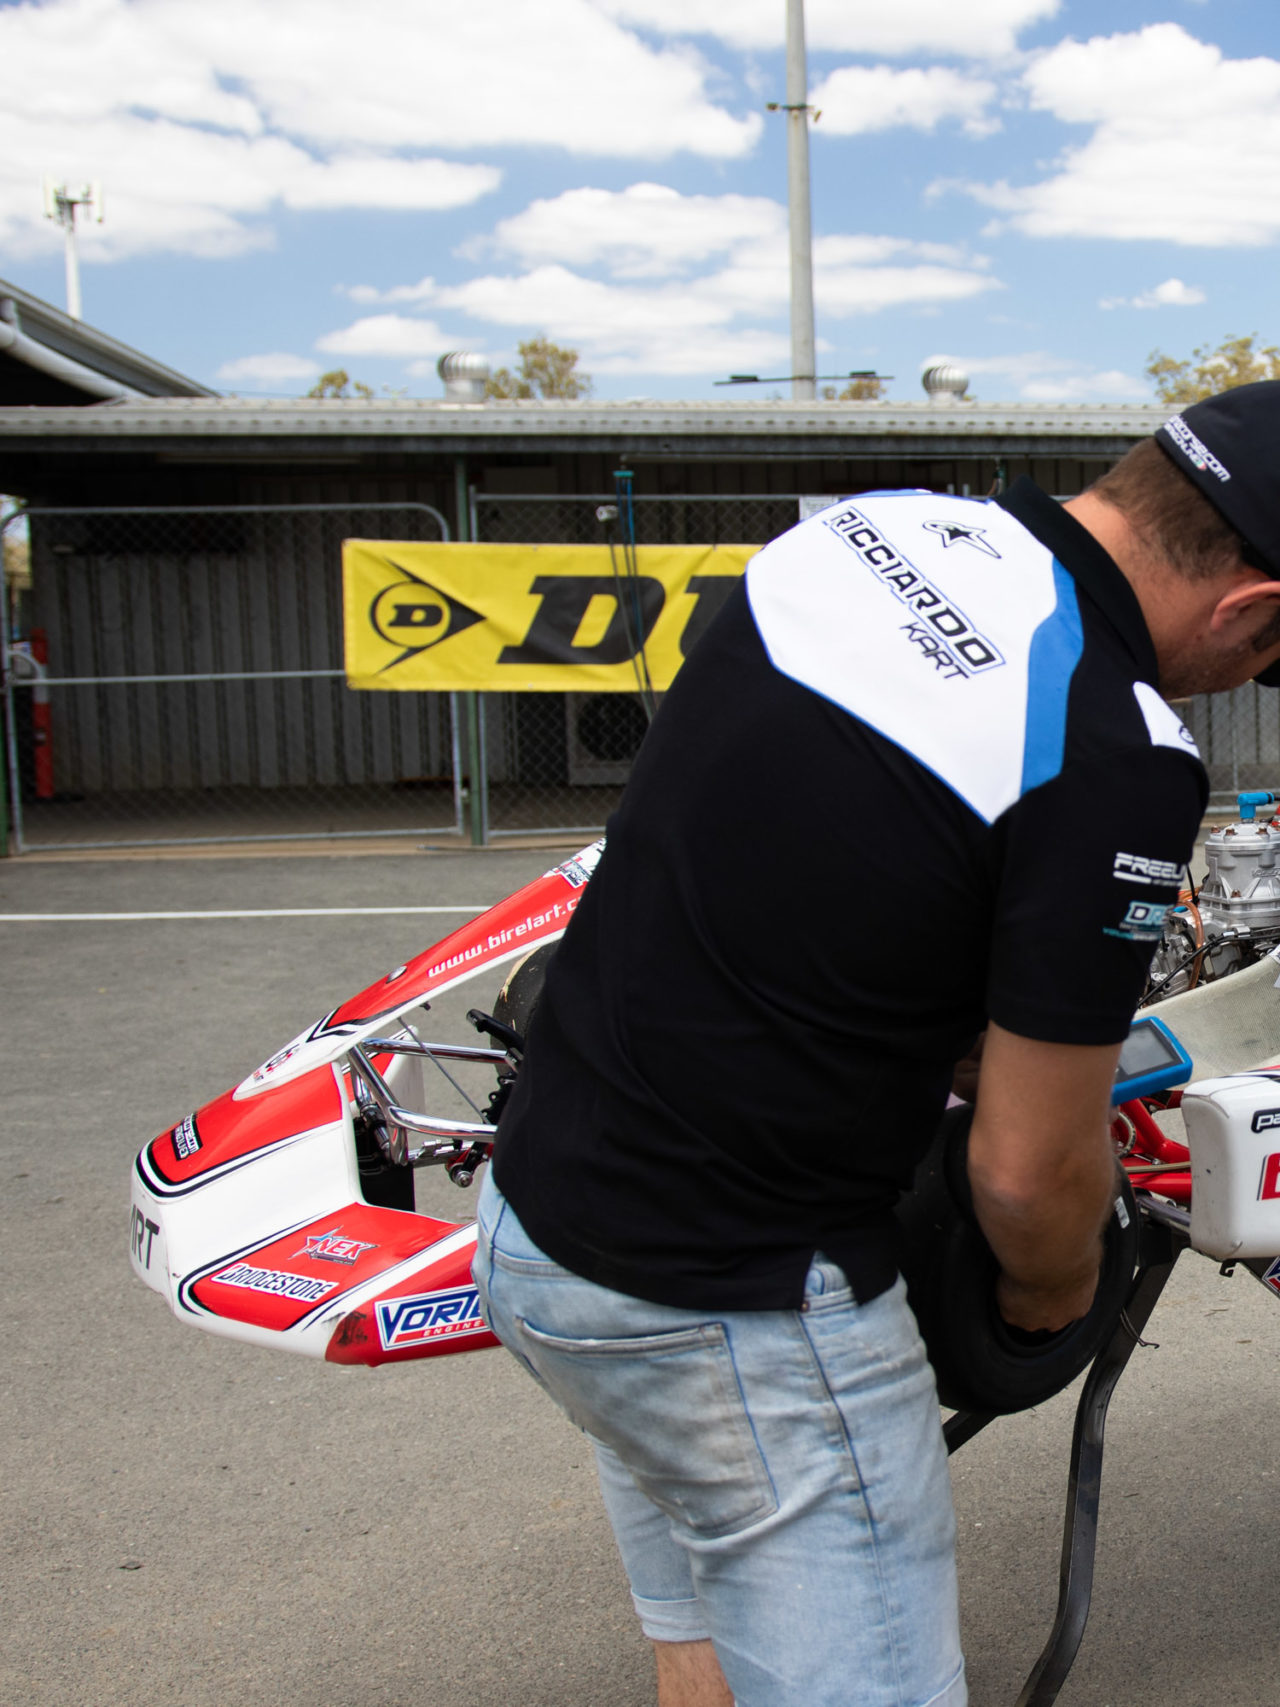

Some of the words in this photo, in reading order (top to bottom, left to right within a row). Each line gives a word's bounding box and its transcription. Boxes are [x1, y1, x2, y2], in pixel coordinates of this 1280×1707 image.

[831, 511, 996, 667] RICCIARDO
[900, 621, 970, 679] KART
[427, 896, 582, 978] www.birelart.c
[308, 1237, 370, 1260] NEK
[220, 1264, 333, 1301] BRIDGESTONE
[423, 1319, 482, 1337] ENGINE
